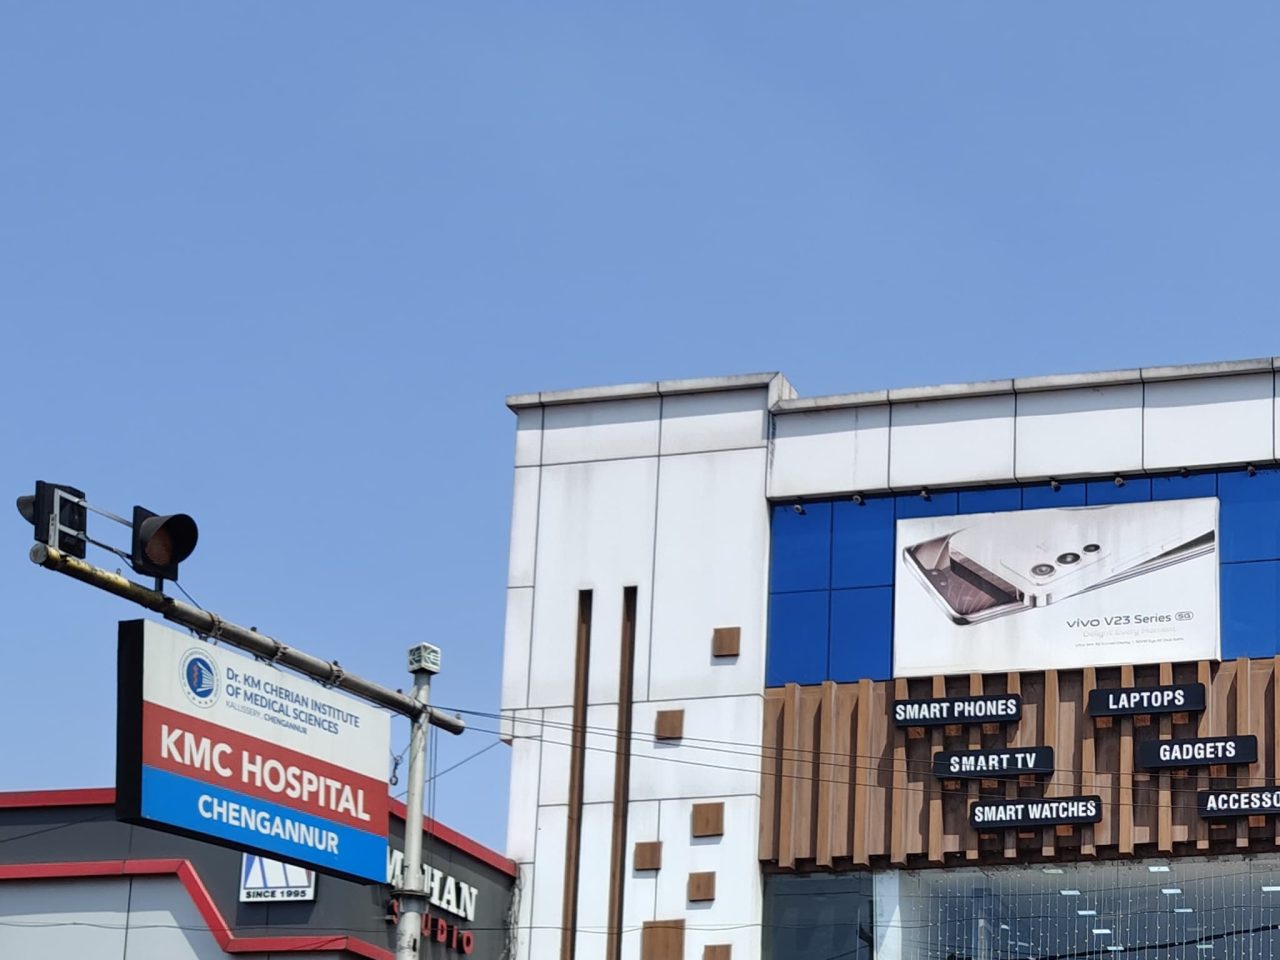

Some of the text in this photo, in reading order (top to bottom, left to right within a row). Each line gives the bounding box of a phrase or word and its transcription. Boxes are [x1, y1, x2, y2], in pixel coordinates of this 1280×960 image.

[1066, 612, 1172, 628] vivo V23 Series
[225, 683, 339, 735] OF MEDICAL SCIENCES
[226, 667, 361, 729] Dr. KM CHERIAN INSTITUTE
[1109, 689, 1185, 709] LAPTOPS
[895, 699, 1017, 721] SMART PHONES
[263, 712, 308, 736] CHENGANNUR
[949, 752, 1036, 773] SMART TV
[1159, 741, 1236, 761] GADGETS
[161, 723, 371, 822] KMC HOSPITAL
[974, 800, 1096, 823] SMART WATCHES
[197, 794, 339, 855] CHENGANNUR
[245, 888, 307, 899] SINCE 1995
[387, 846, 478, 922] MHAN
[387, 898, 476, 955] SUDIO
